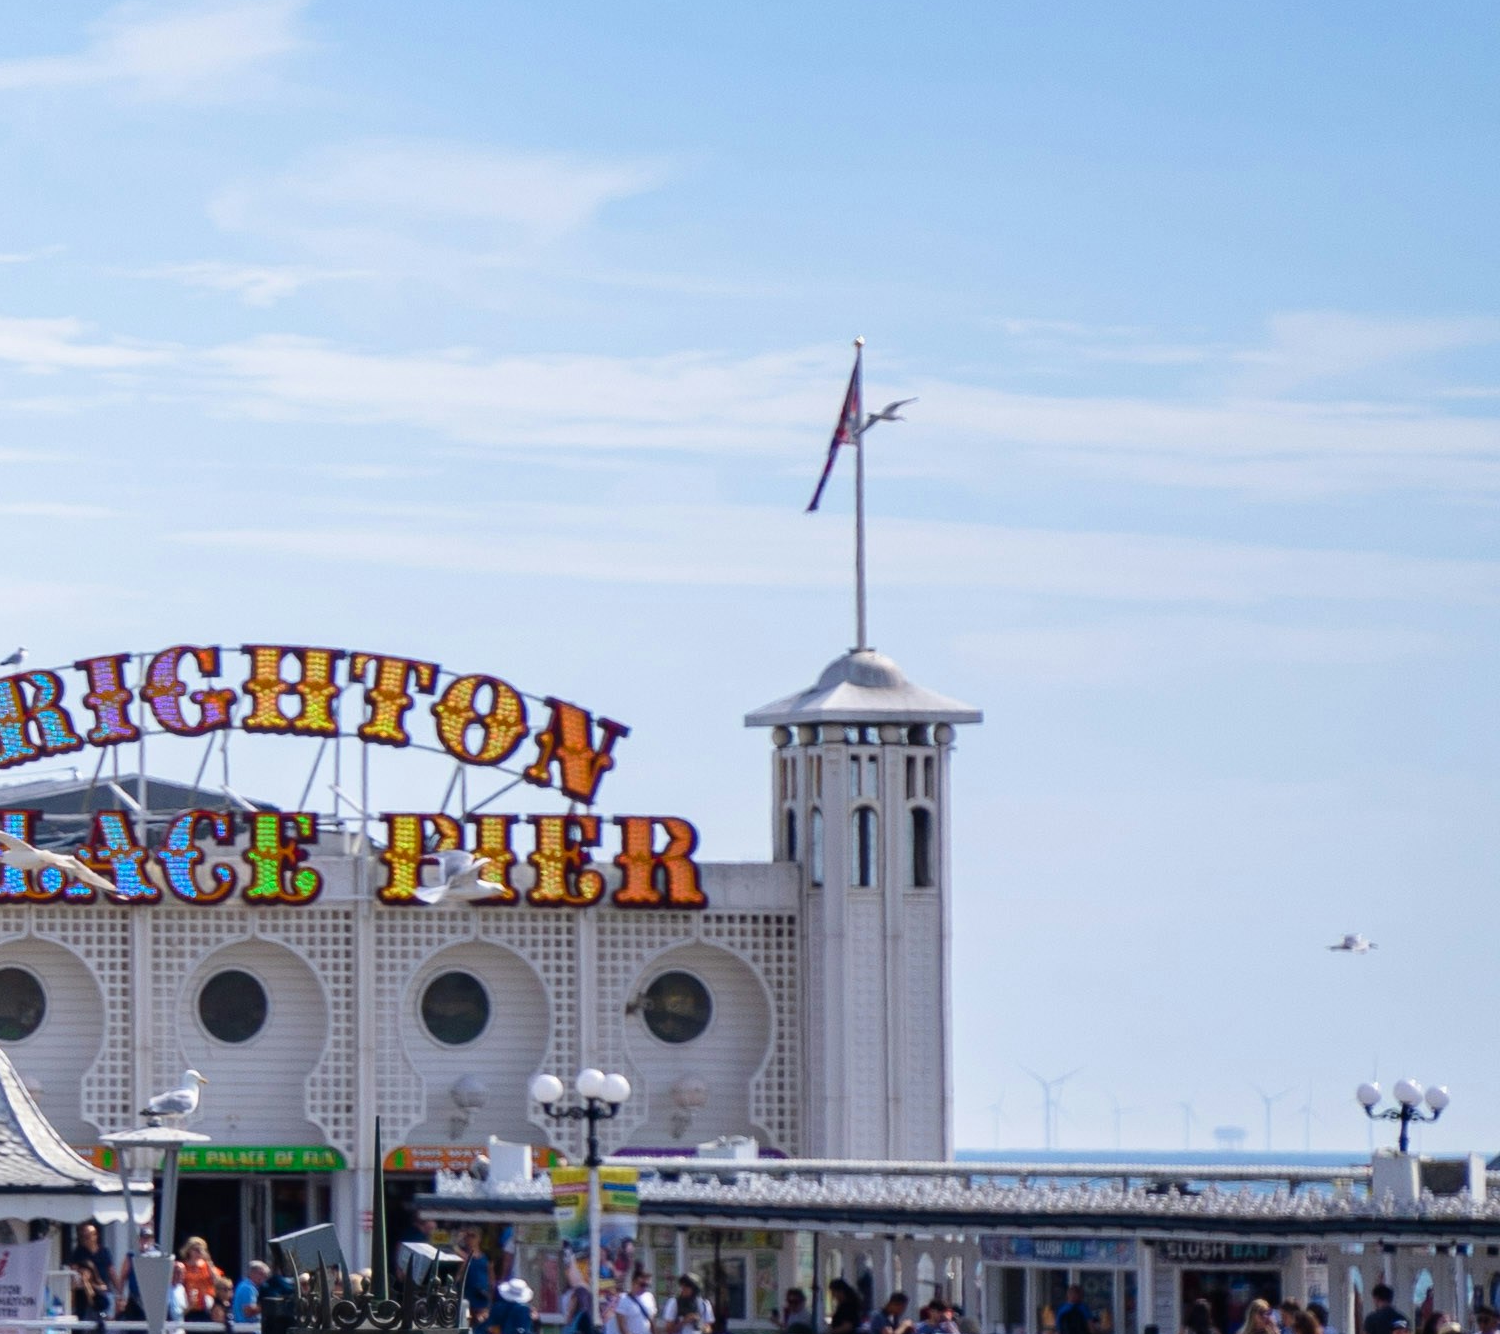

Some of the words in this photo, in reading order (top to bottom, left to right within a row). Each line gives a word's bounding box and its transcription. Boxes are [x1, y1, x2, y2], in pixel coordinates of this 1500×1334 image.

[377, 812, 708, 910] PIER
[205, 1150, 266, 1166] PALACE
[275, 1150, 294, 1166] OF
[1035, 1240, 1062, 1257] SLUSH
[1167, 1241, 1226, 1260] SLUSH
[1232, 1243, 1269, 1259] BAR
